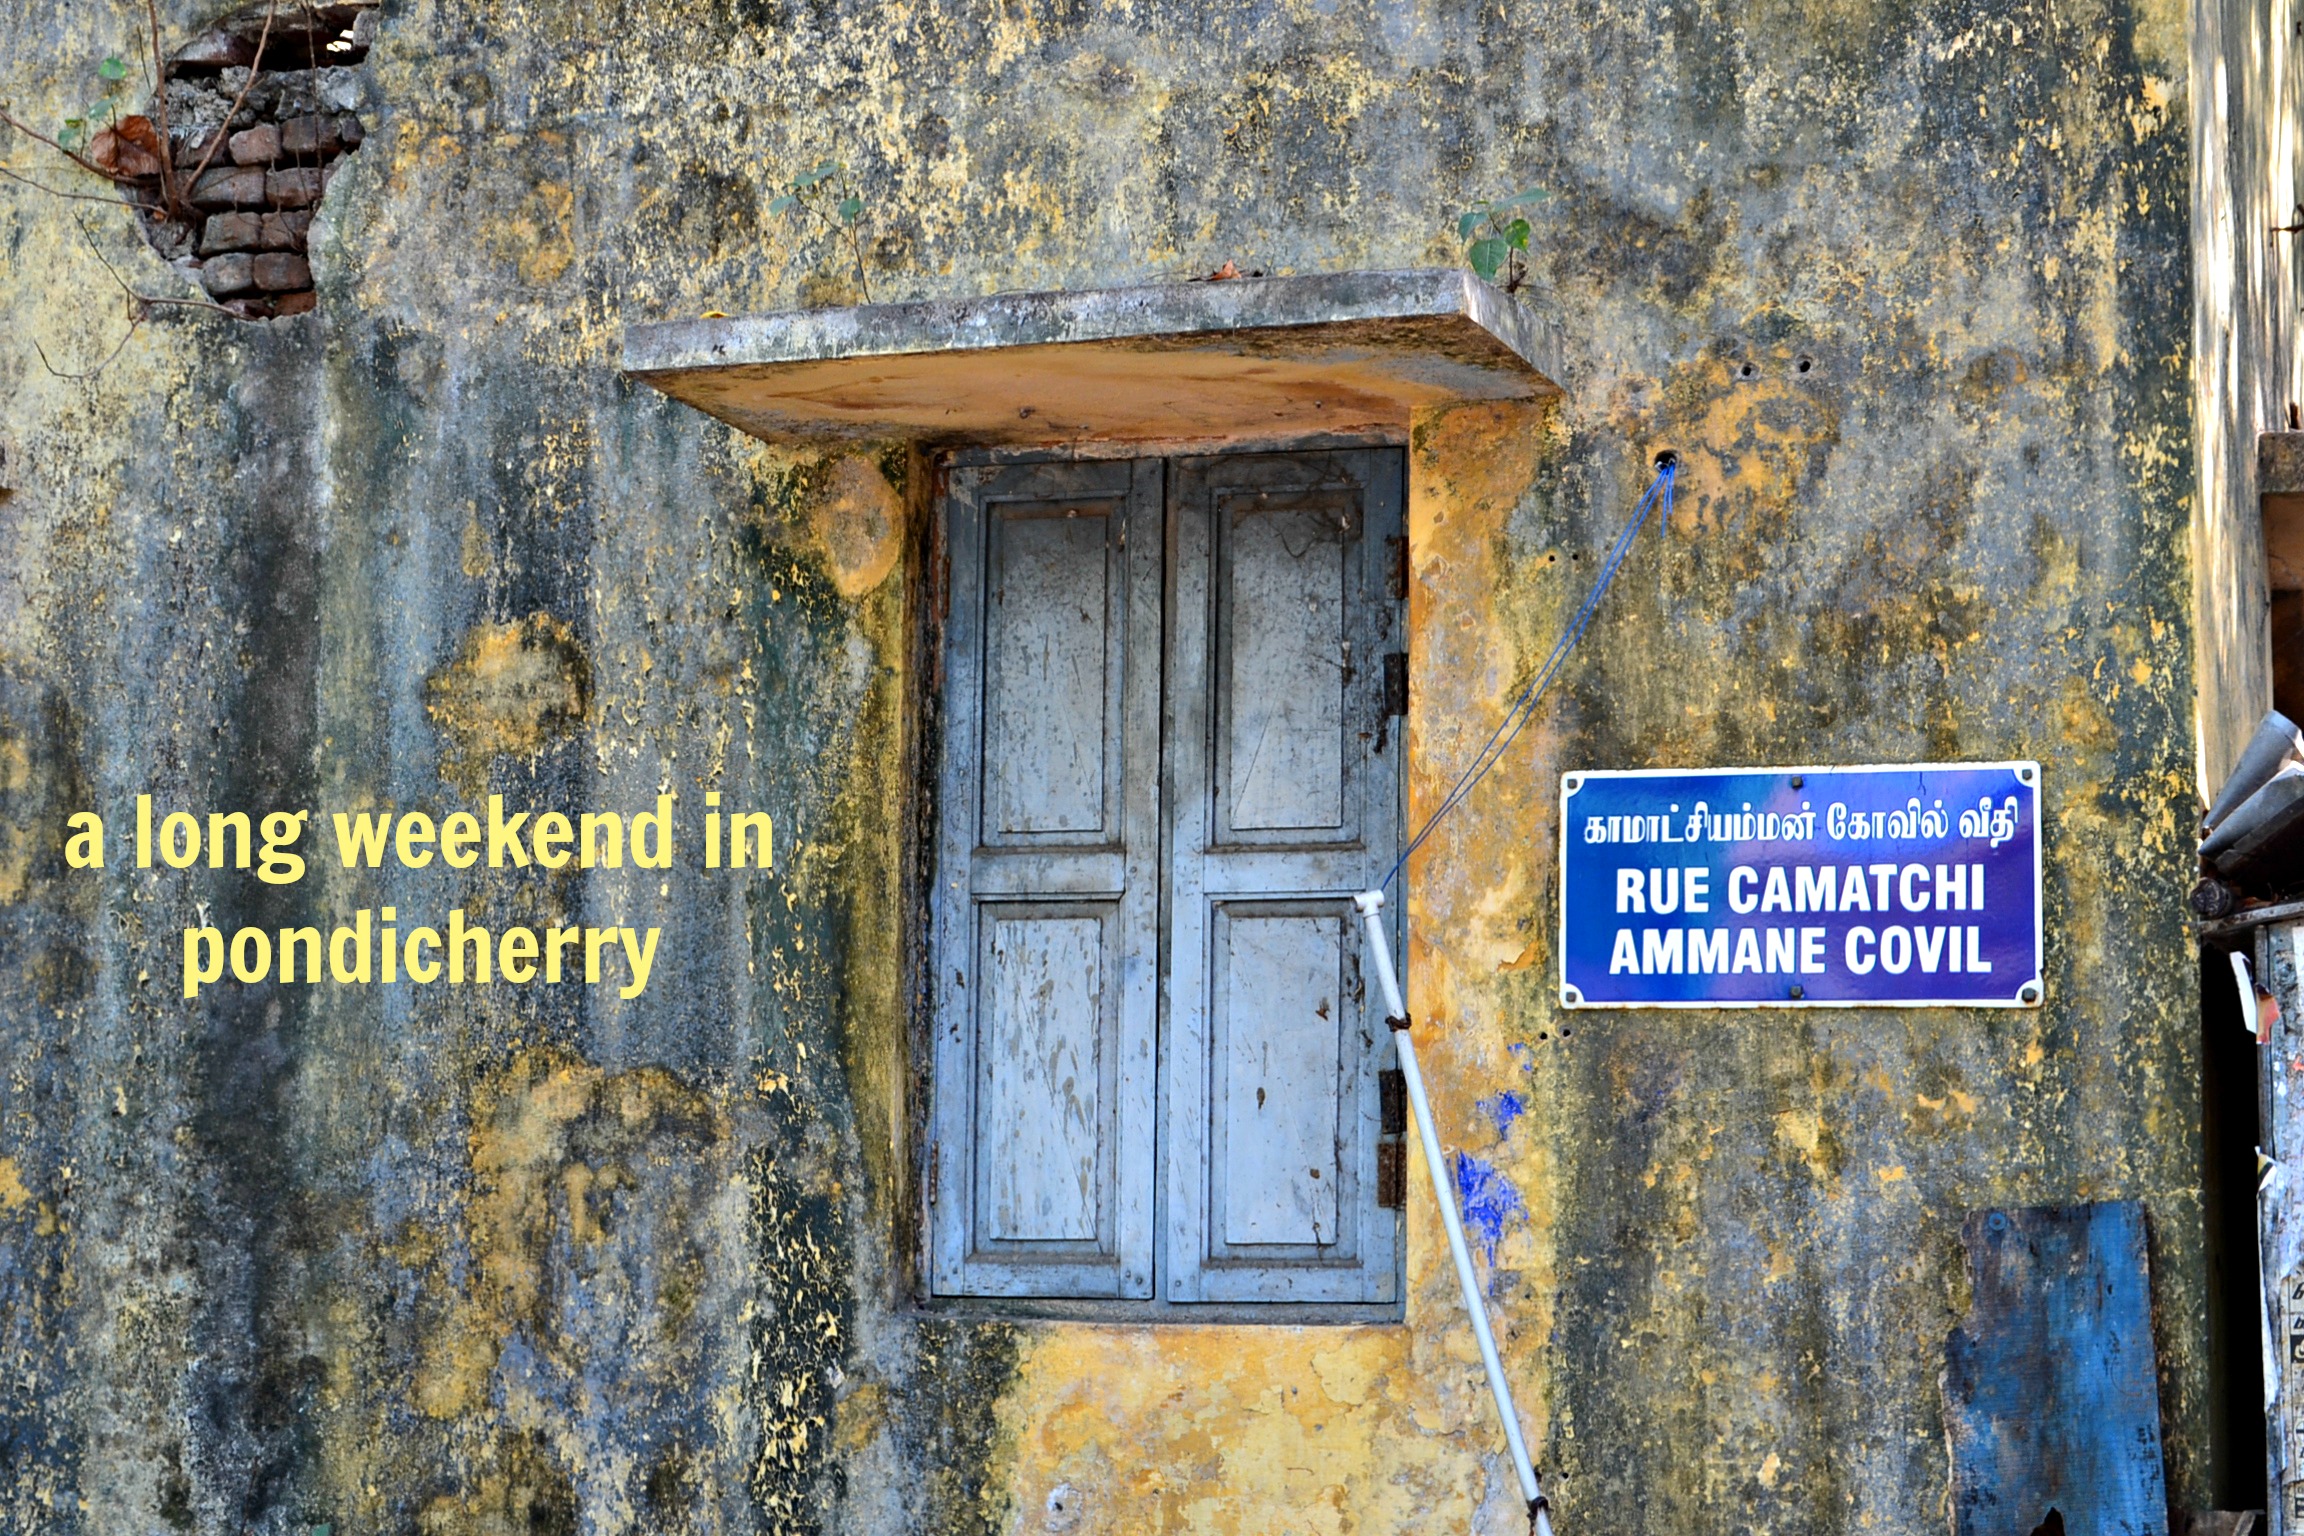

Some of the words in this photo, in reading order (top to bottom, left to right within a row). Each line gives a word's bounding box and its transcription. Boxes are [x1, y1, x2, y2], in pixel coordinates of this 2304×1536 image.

[1584, 801, 1816, 844] காமாட்சியம்மன்
[1827, 797, 1949, 840] கோவில்
[1959, 796, 2019, 848] வீதி
[1616, 867, 1709, 913] RUE
[1728, 864, 1984, 913] CAMATCHI
[1609, 928, 1826, 975] AMMANE
[1845, 926, 1992, 975] COVIL
